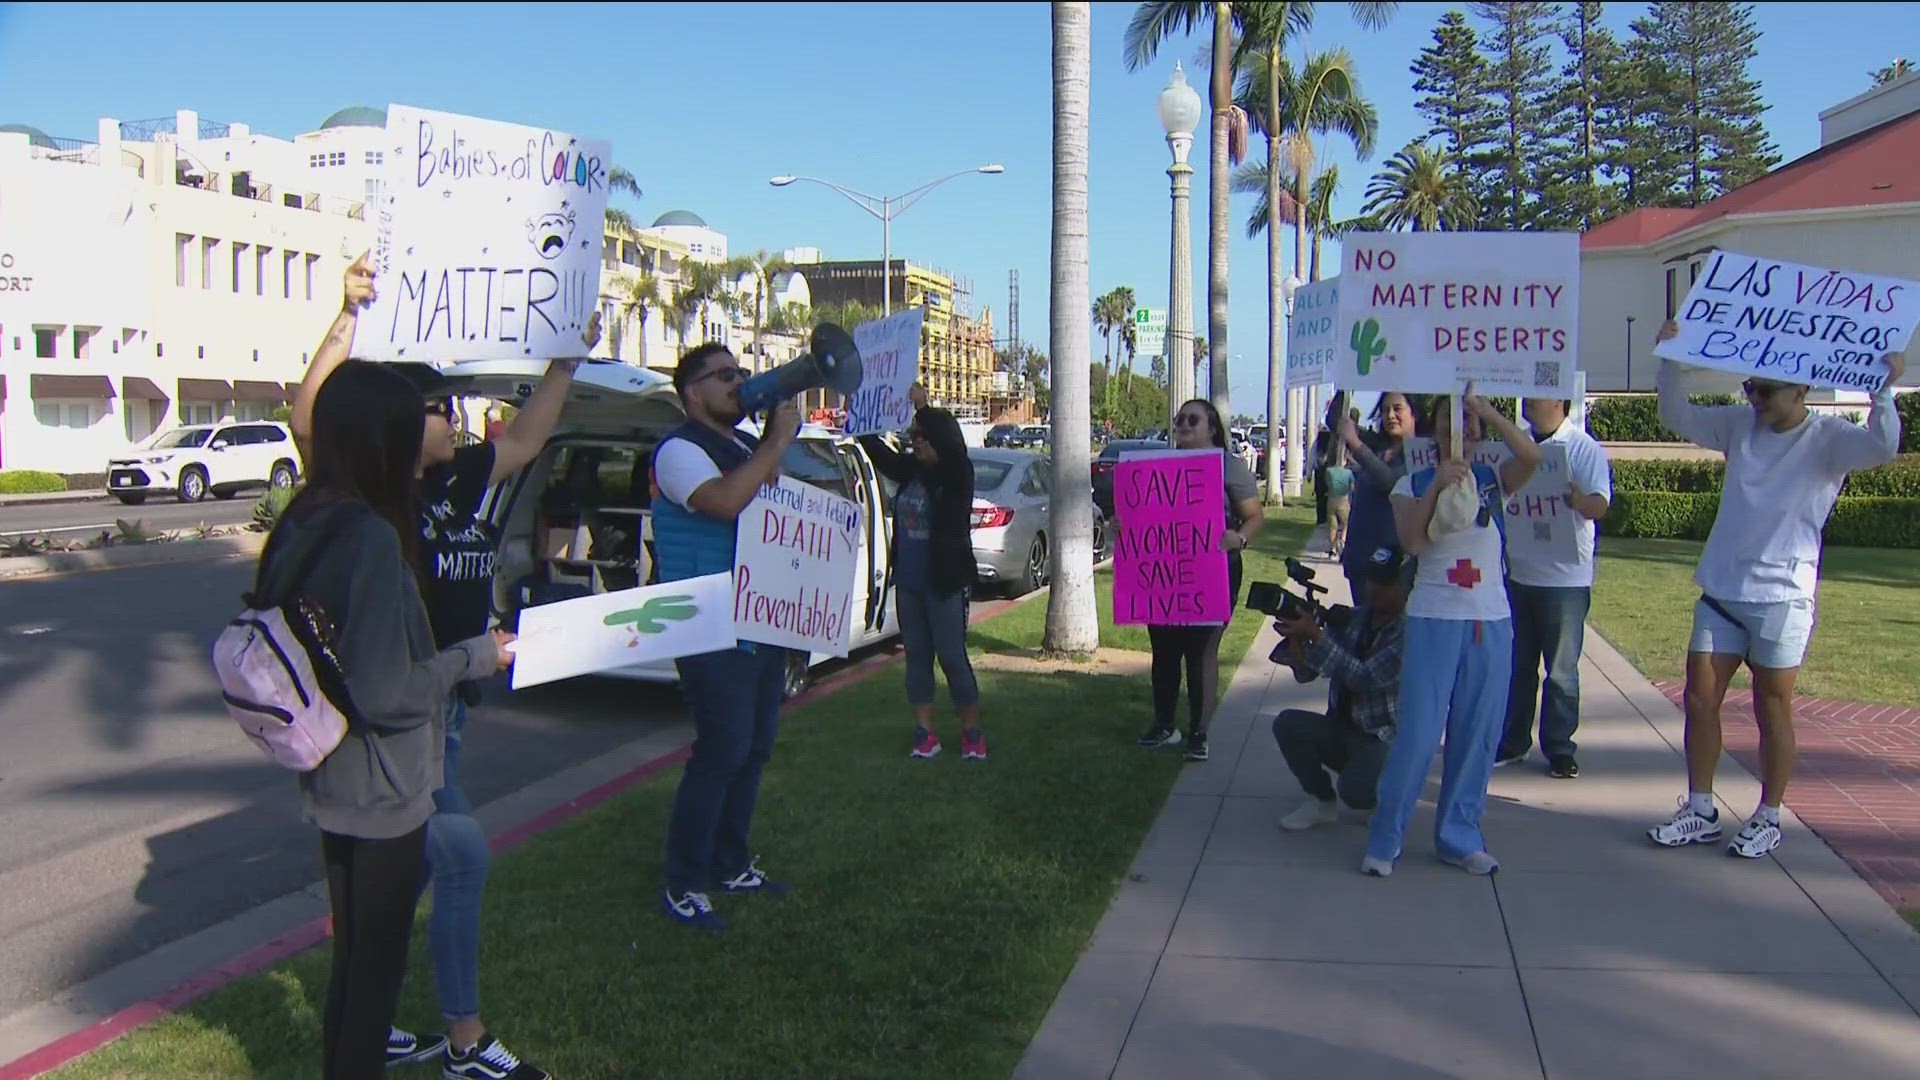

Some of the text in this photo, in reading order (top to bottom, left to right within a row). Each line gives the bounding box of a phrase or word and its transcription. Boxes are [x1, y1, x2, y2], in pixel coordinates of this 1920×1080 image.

[417, 119, 498, 188] Babies
[511, 138, 537, 181] of
[1355, 248, 1396, 272] NO
[1704, 253, 1782, 299] LAS
[390, 266, 587, 344] MATTER!!!
[1296, 293, 1322, 312] ALL
[1371, 282, 1564, 310] MATERNITY
[1140, 310, 1147, 322] 2
[1296, 316, 1333, 339] AND
[1685, 298, 1900, 352] DE NUESTROS
[1434, 326, 1567, 353] DESERTS
[1687, 329, 1811, 376] Bebes
[1289, 347, 1335, 369] DESER
[757, 483, 806, 514] aternal
[1124, 468, 1205, 509] SAVE
[762, 508, 833, 562] DEATH
[1116, 520, 1212, 561] WOMEN
[438, 550, 496, 581] MATTER
[1138, 558, 1195, 591] SAVE
[734, 564, 850, 646] Preventable!
[1130, 591, 1205, 621] LIVES
